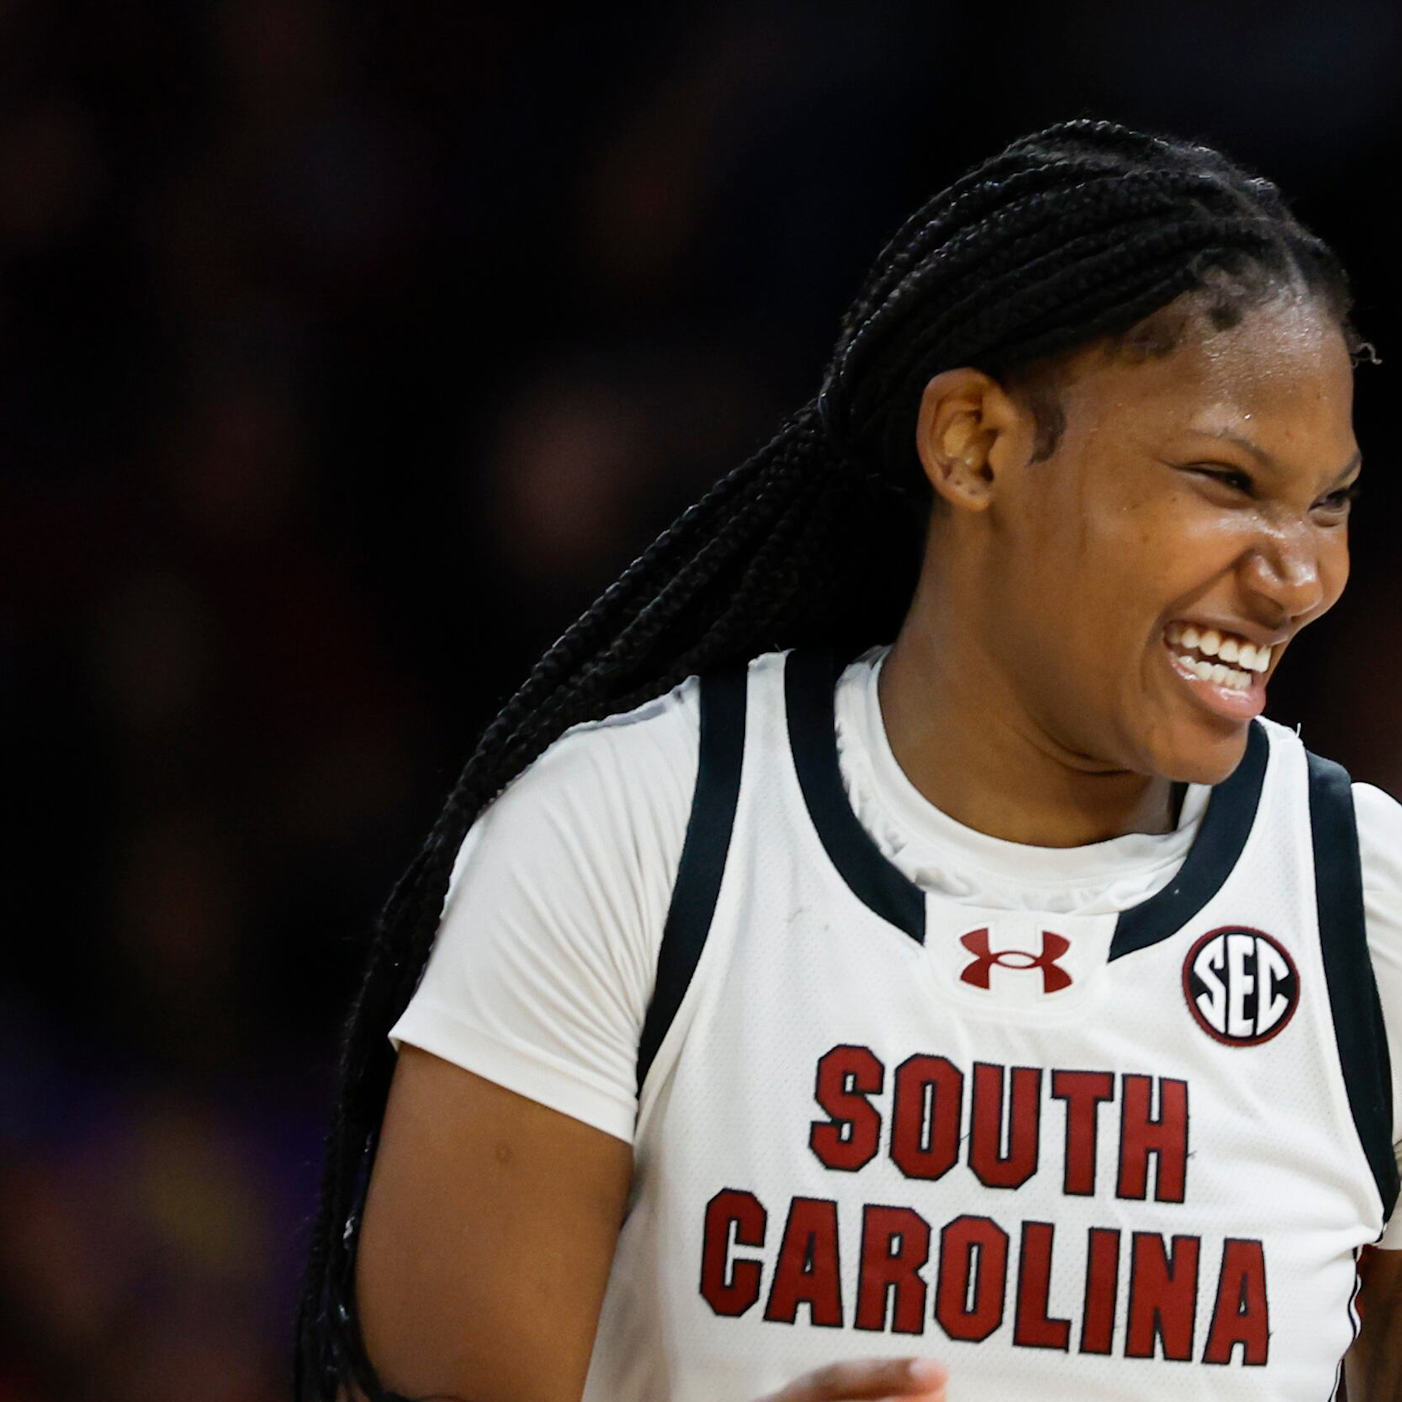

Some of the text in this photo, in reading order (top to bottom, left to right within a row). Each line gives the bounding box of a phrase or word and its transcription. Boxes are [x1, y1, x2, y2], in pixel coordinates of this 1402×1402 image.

[1194, 934, 1290, 1037] SEC
[808, 1043, 1191, 1204] SOUTH
[698, 1187, 1269, 1368] CAROLINA
